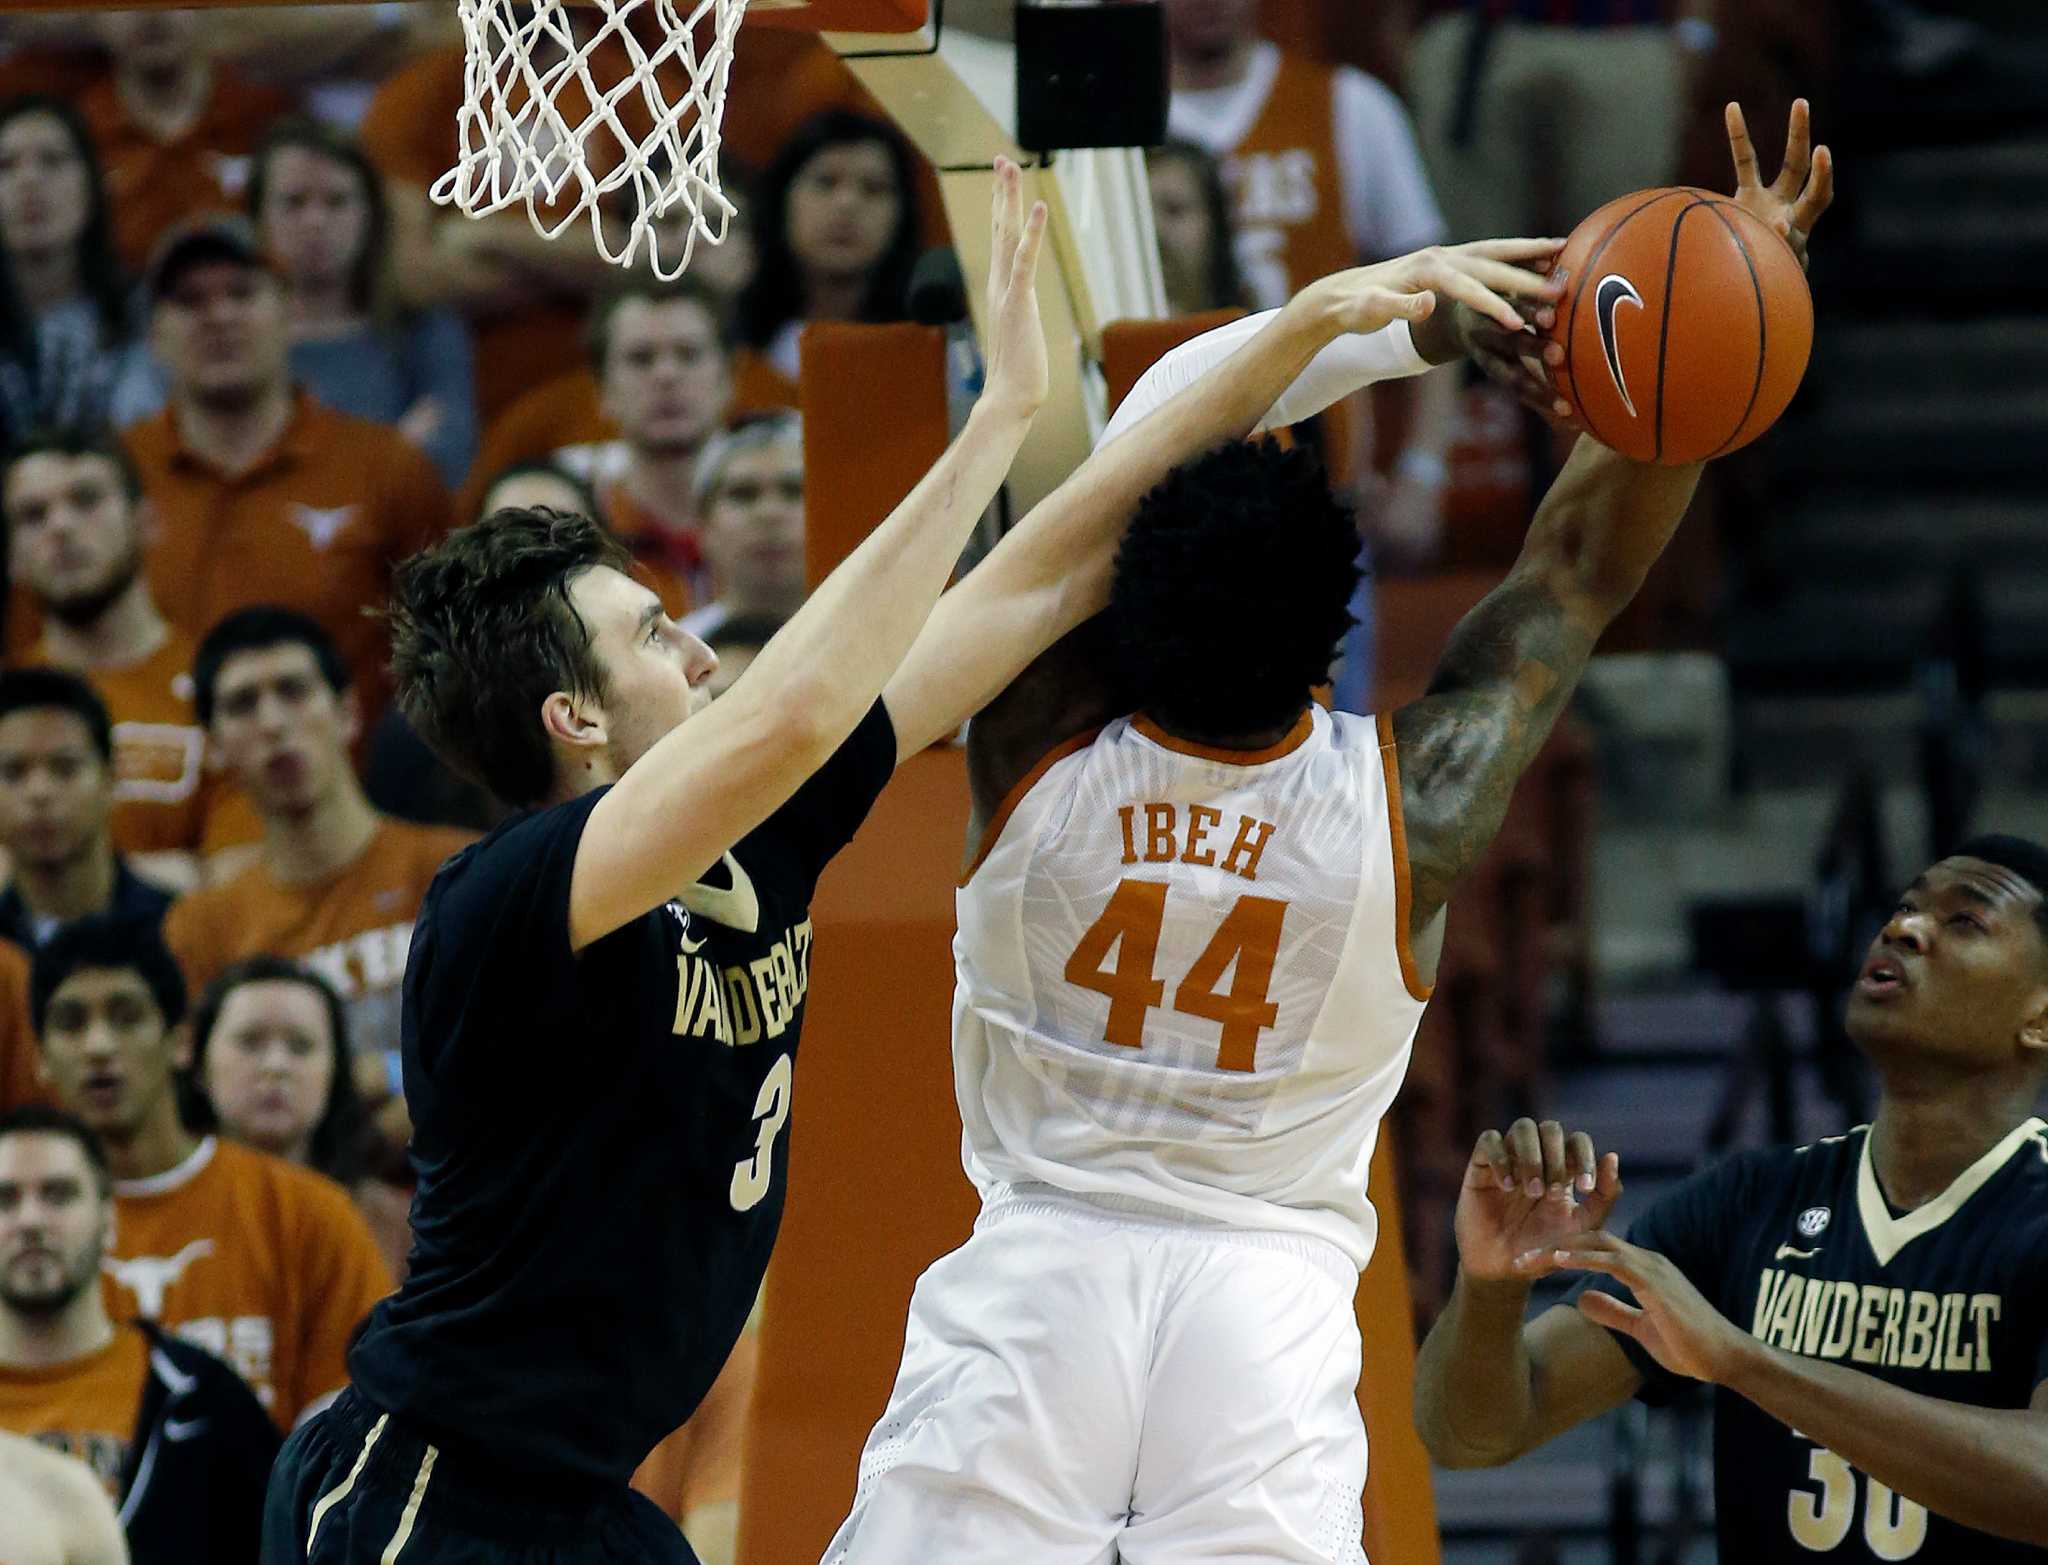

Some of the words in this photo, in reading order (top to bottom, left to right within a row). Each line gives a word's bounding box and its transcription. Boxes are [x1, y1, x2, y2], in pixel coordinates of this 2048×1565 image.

[1117, 802, 1277, 881] IBEH
[671, 917, 813, 1047] VADEBLT
[1064, 878, 1290, 1073] 44
[729, 1052, 792, 1212] 3
[1752, 1268, 2001, 1372] VANDERBILT
[1787, 1428, 1928, 1562] 30
